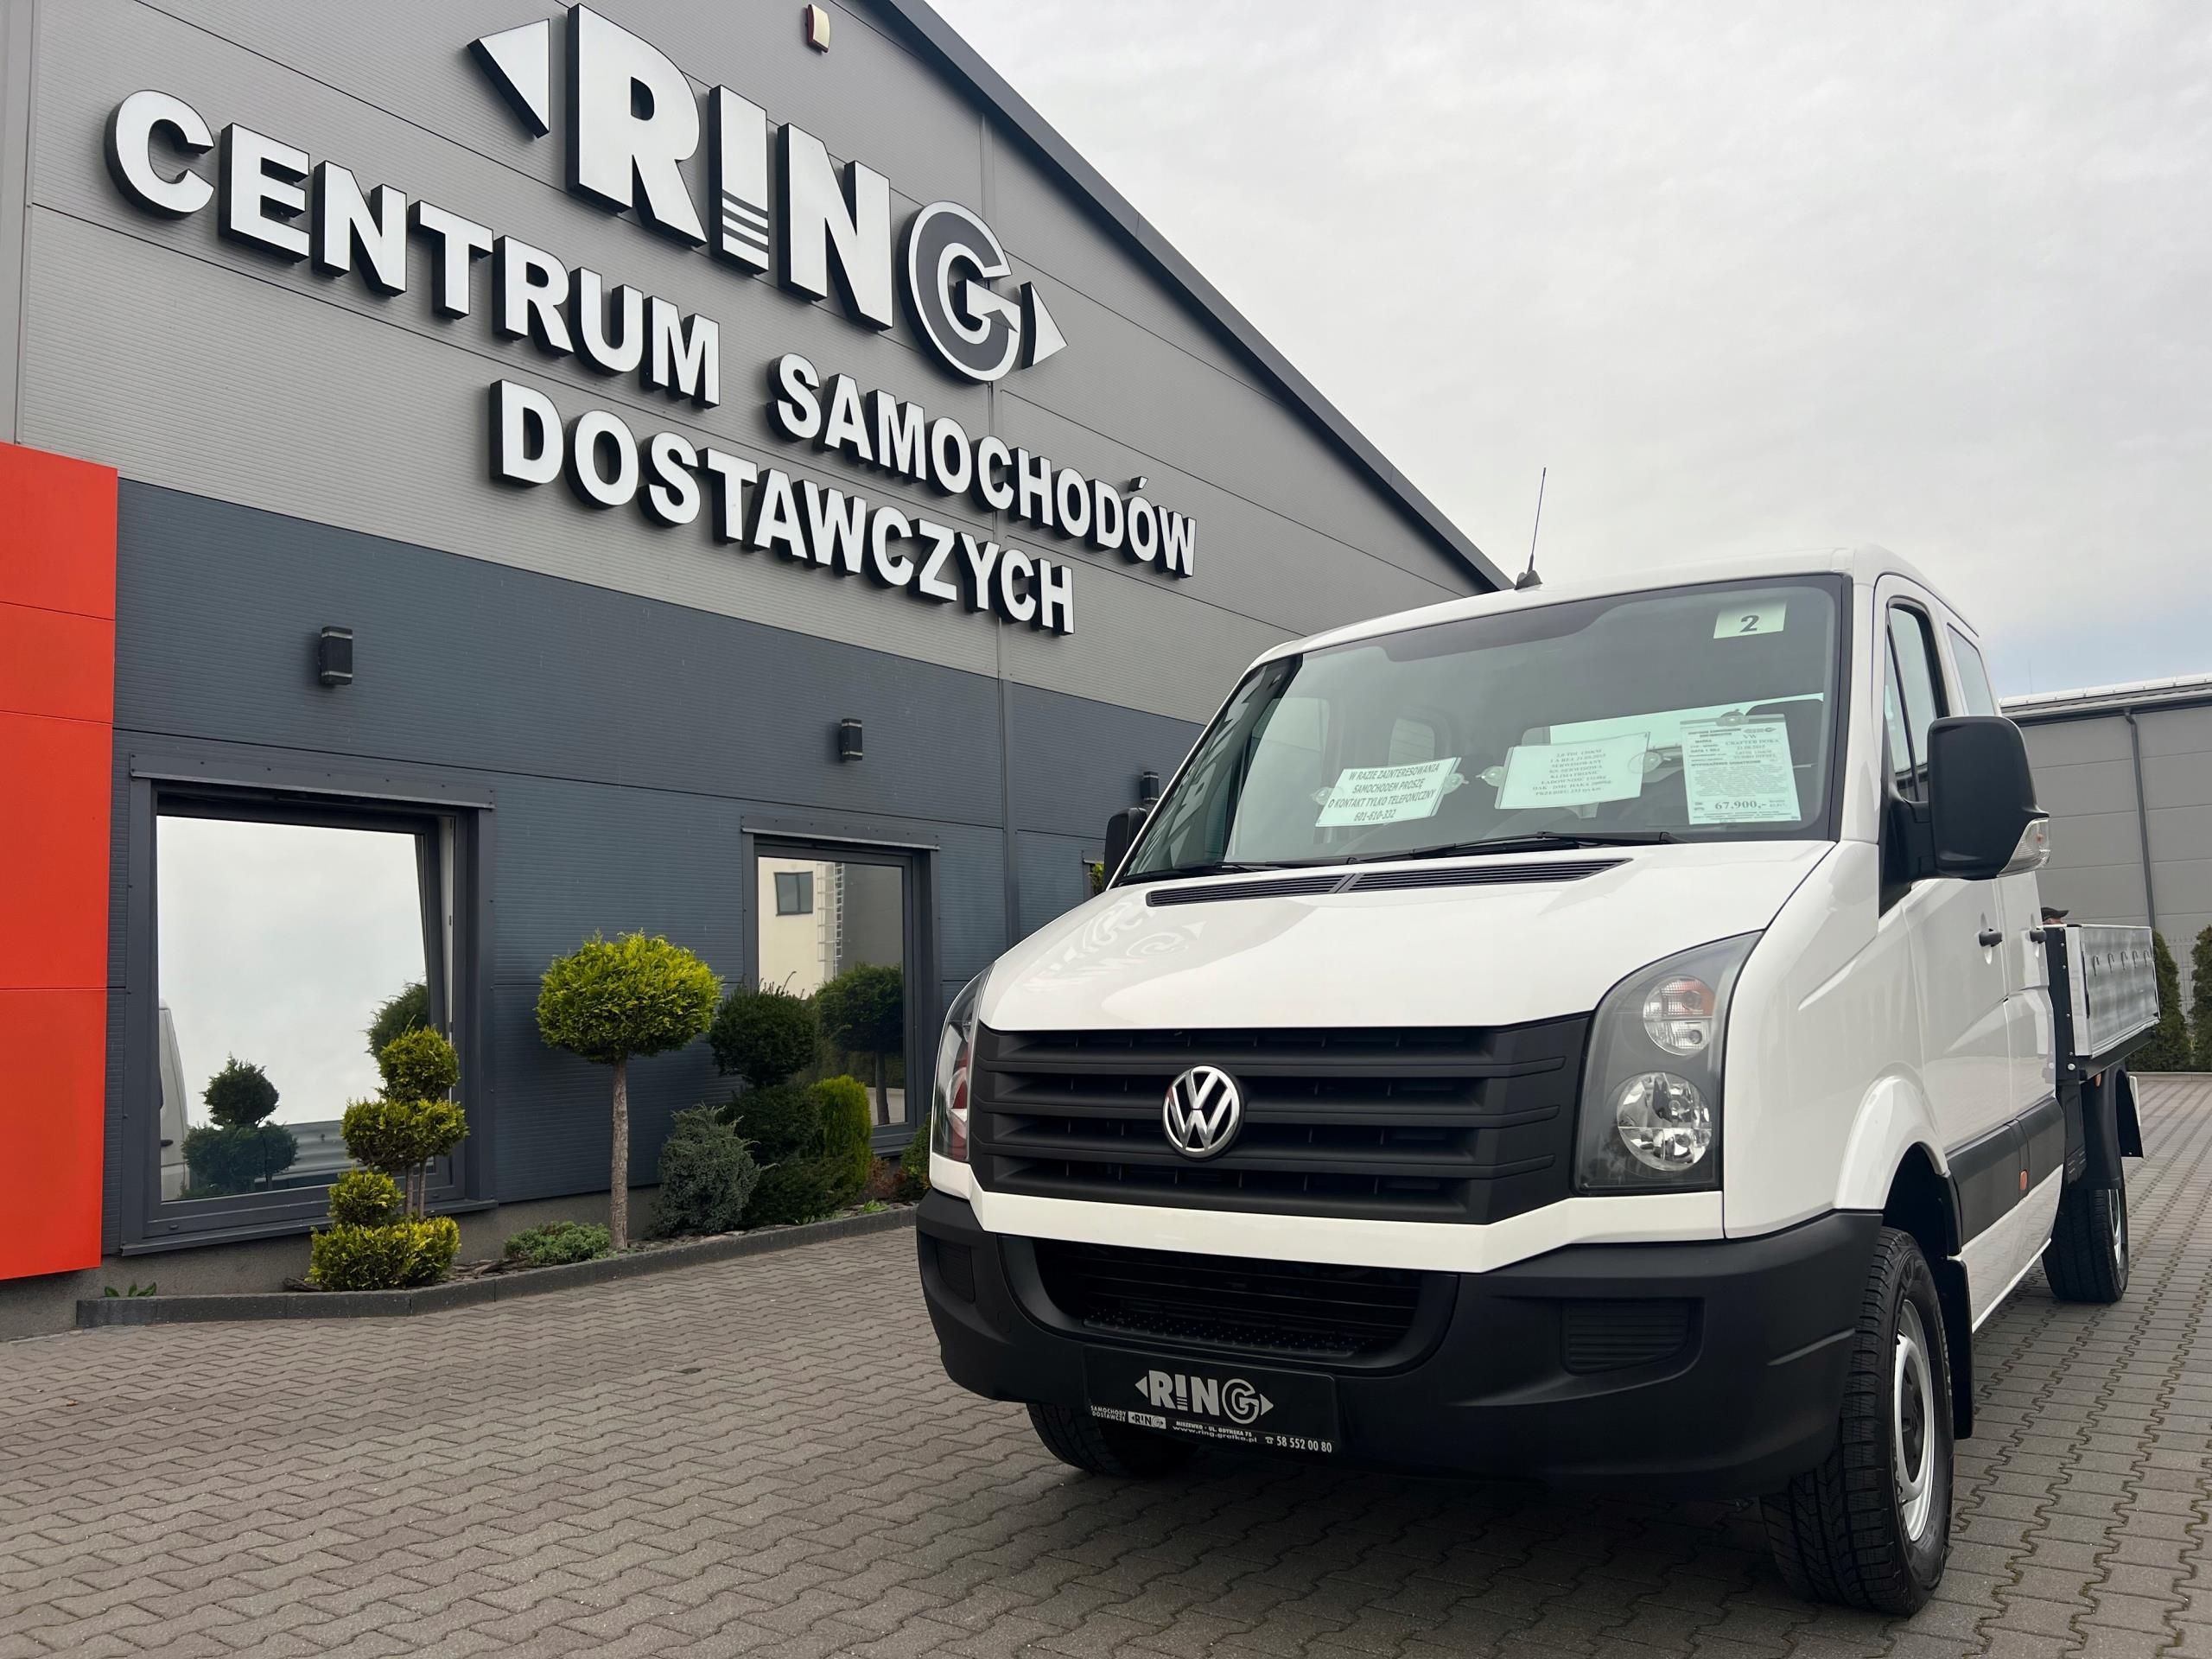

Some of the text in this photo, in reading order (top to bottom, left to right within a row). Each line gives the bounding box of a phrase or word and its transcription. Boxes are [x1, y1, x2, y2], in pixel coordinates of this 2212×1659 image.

[567, 3, 1022, 384] RING
[105, 89, 1197, 577] CENTRUM SAMOCHODÓW
[489, 378, 1075, 634] DOSTAWCZYCH
[1739, 614, 1759, 632] 2
[1349, 762, 1440, 780] W RAZIE ZAINTERESOWANIA
[1352, 778, 1426, 794] SAMOCHODEM PROSZĘ
[1328, 788, 1437, 808] O KONTAKT TYLKO TELEFONICZNY
[1148, 1370, 1259, 1424] RING
[1090, 1405, 1127, 1417] SAMOCHODY
[1276, 1435, 1332, 1453] 58 552 00 80
